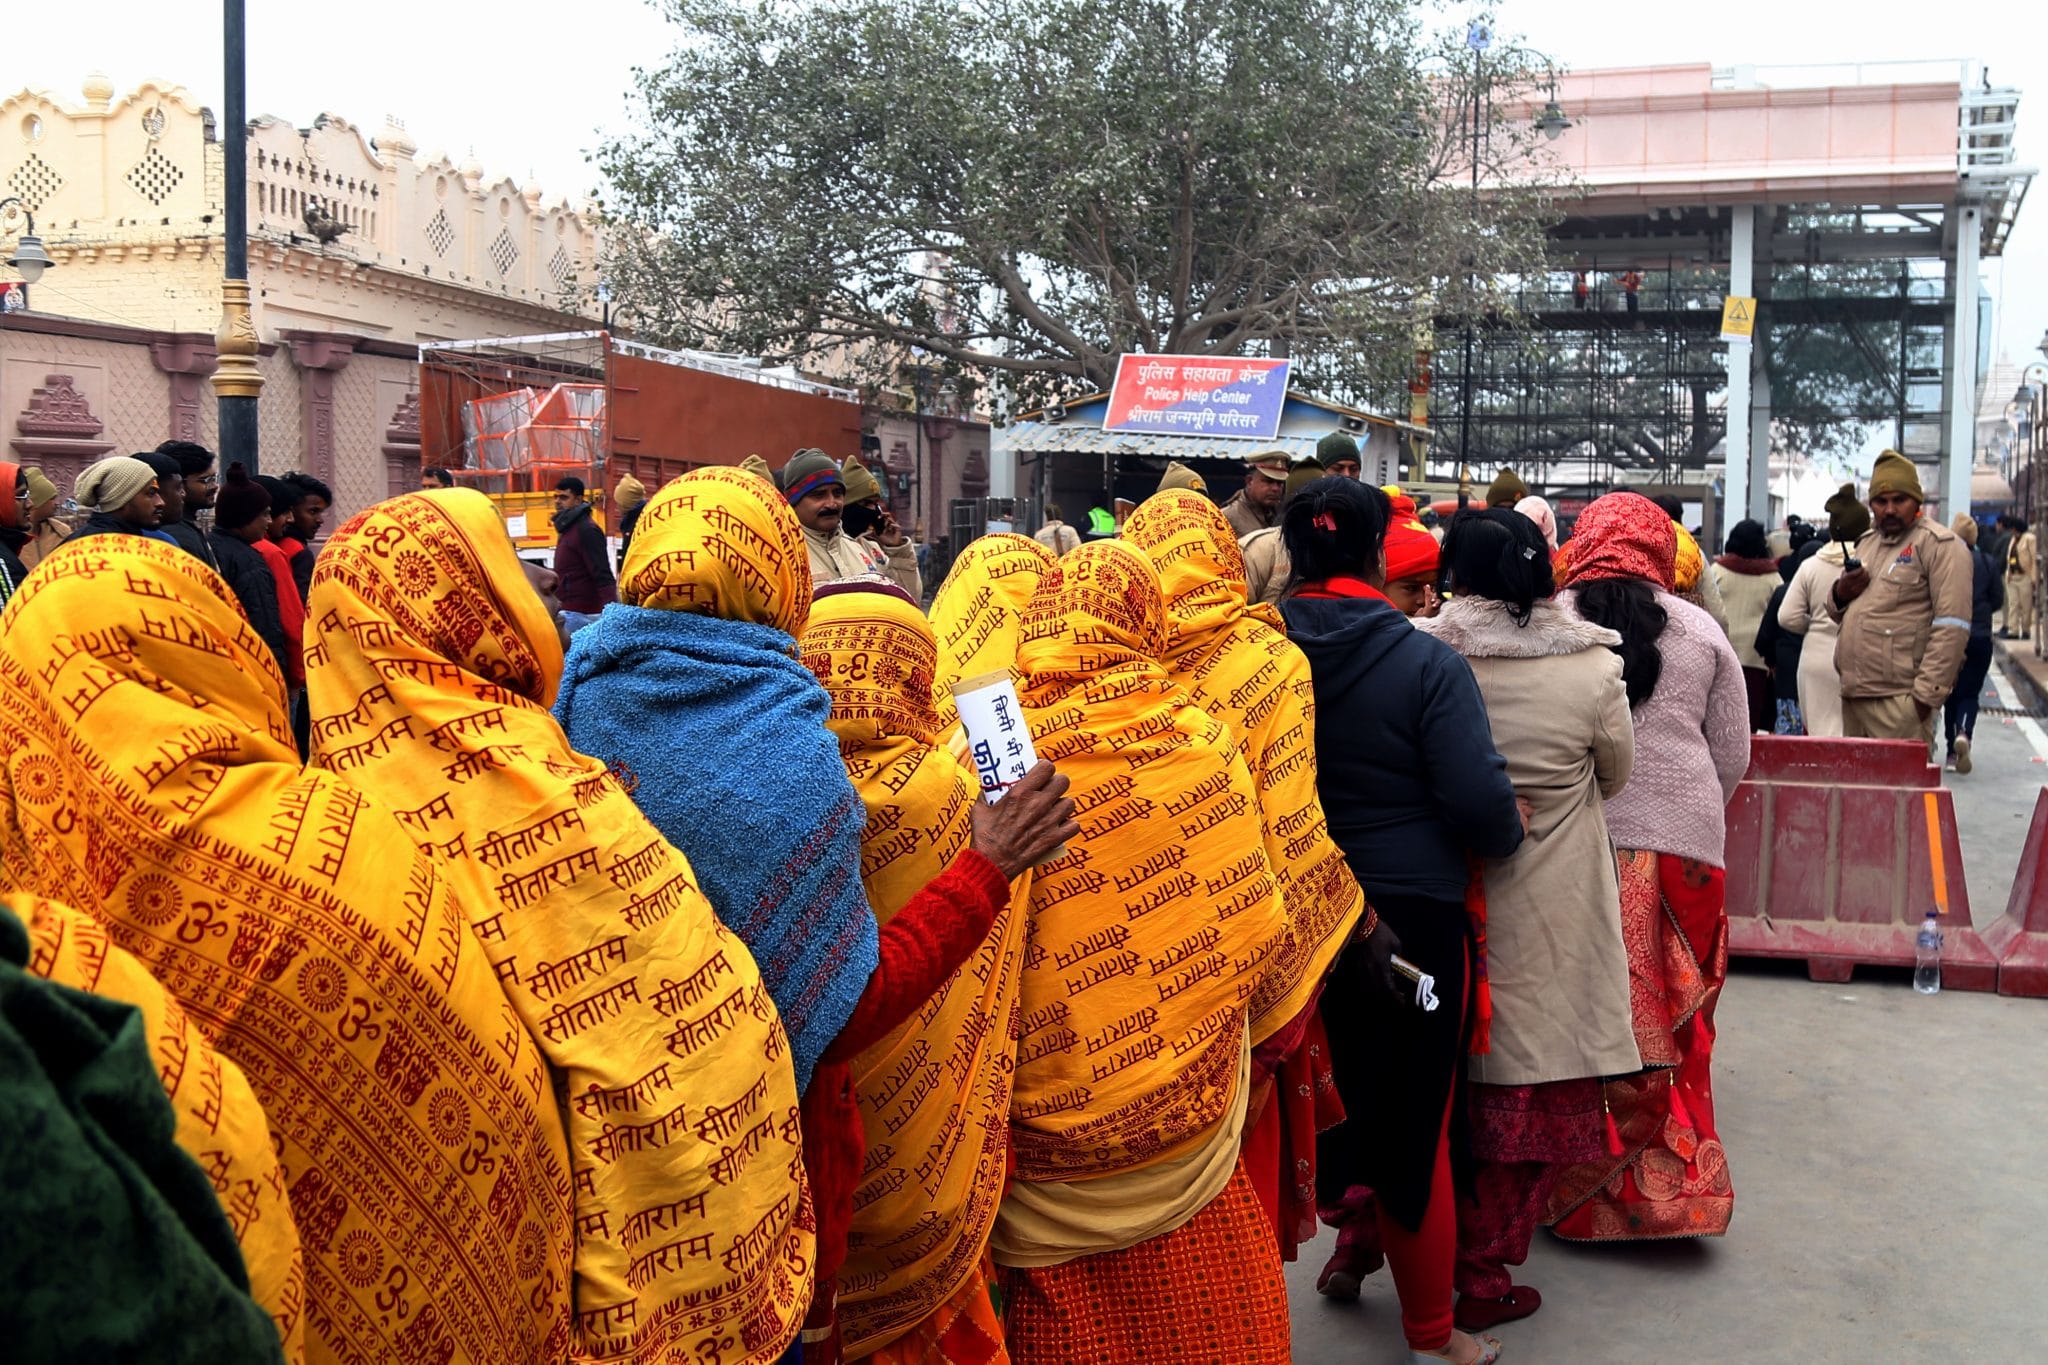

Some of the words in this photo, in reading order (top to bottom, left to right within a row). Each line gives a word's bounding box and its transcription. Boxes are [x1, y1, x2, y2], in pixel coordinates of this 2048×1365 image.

[1136, 361, 1176, 385] पुलिस
[1181, 365, 1233, 383] सहायता
[1239, 364, 1270, 385] केन्द्र
[1144, 386, 1180, 401] Police
[1182, 389, 1210, 405] Help
[1212, 391, 1251, 405] Center
[1127, 405, 1164, 423] श्रीराम
[1165, 409, 1217, 430] जन्मभूमि
[1219, 410, 1261, 429] परिसर
[702, 505, 783, 575] सीताराम
[702, 533, 776, 607] सीताराम
[1167, 580, 1229, 612] सीताराम
[945, 586, 994, 648] सीताराम
[955, 607, 1008, 668] सीताराम
[1193, 630, 1243, 680] सीताराम
[1228, 660, 1279, 709] सीताराम
[992, 694, 1016, 732] किसी
[1006, 737, 1024, 757] भी
[1106, 708, 1176, 753] सीताराम
[1163, 771, 1233, 818] सीताराम
[1261, 747, 1310, 791] सीताराम
[473, 807, 587, 872] सीताराम
[1079, 797, 1157, 842] सीताराम
[1180, 792, 1248, 841] सीताराम
[1282, 819, 1328, 861] सीताराम
[495, 847, 601, 912] सीताराम
[606, 839, 671, 891] सीताराम
[1113, 844, 1189, 894] सीताराम
[619, 873, 696, 932] सीताराम
[1030, 870, 1109, 915] सीताराम
[1125, 871, 1200, 921] सीताराम
[525, 935, 628, 1001] सीताराम
[1053, 924, 1132, 971] सीताराम
[1148, 926, 1223, 976] सीताराम
[648, 949, 735, 1018] सीताराम
[1065, 950, 1143, 998] सीताराम
[1157, 951, 1230, 1003] सीताराम
[539, 976, 642, 1044] सीताराम
[664, 986, 748, 1058] सीताराम
[1085, 1006, 1160, 1056] सीताराम
[1170, 1004, 1238, 1059] सीताराम
[868, 1038, 931, 1113] सीताराम
[1091, 1033, 1166, 1083] सीताराम
[574, 1063, 674, 1120] सीताराम
[693, 1072, 768, 1145] सीताराम
[883, 1061, 943, 1137] सीताराम
[1018, 1087, 1094, 1121] सीताराम
[587, 1104, 688, 1165] सीताराम
[707, 1112, 777, 1186] सीताराम
[720, 1193, 791, 1274] सीताराम
